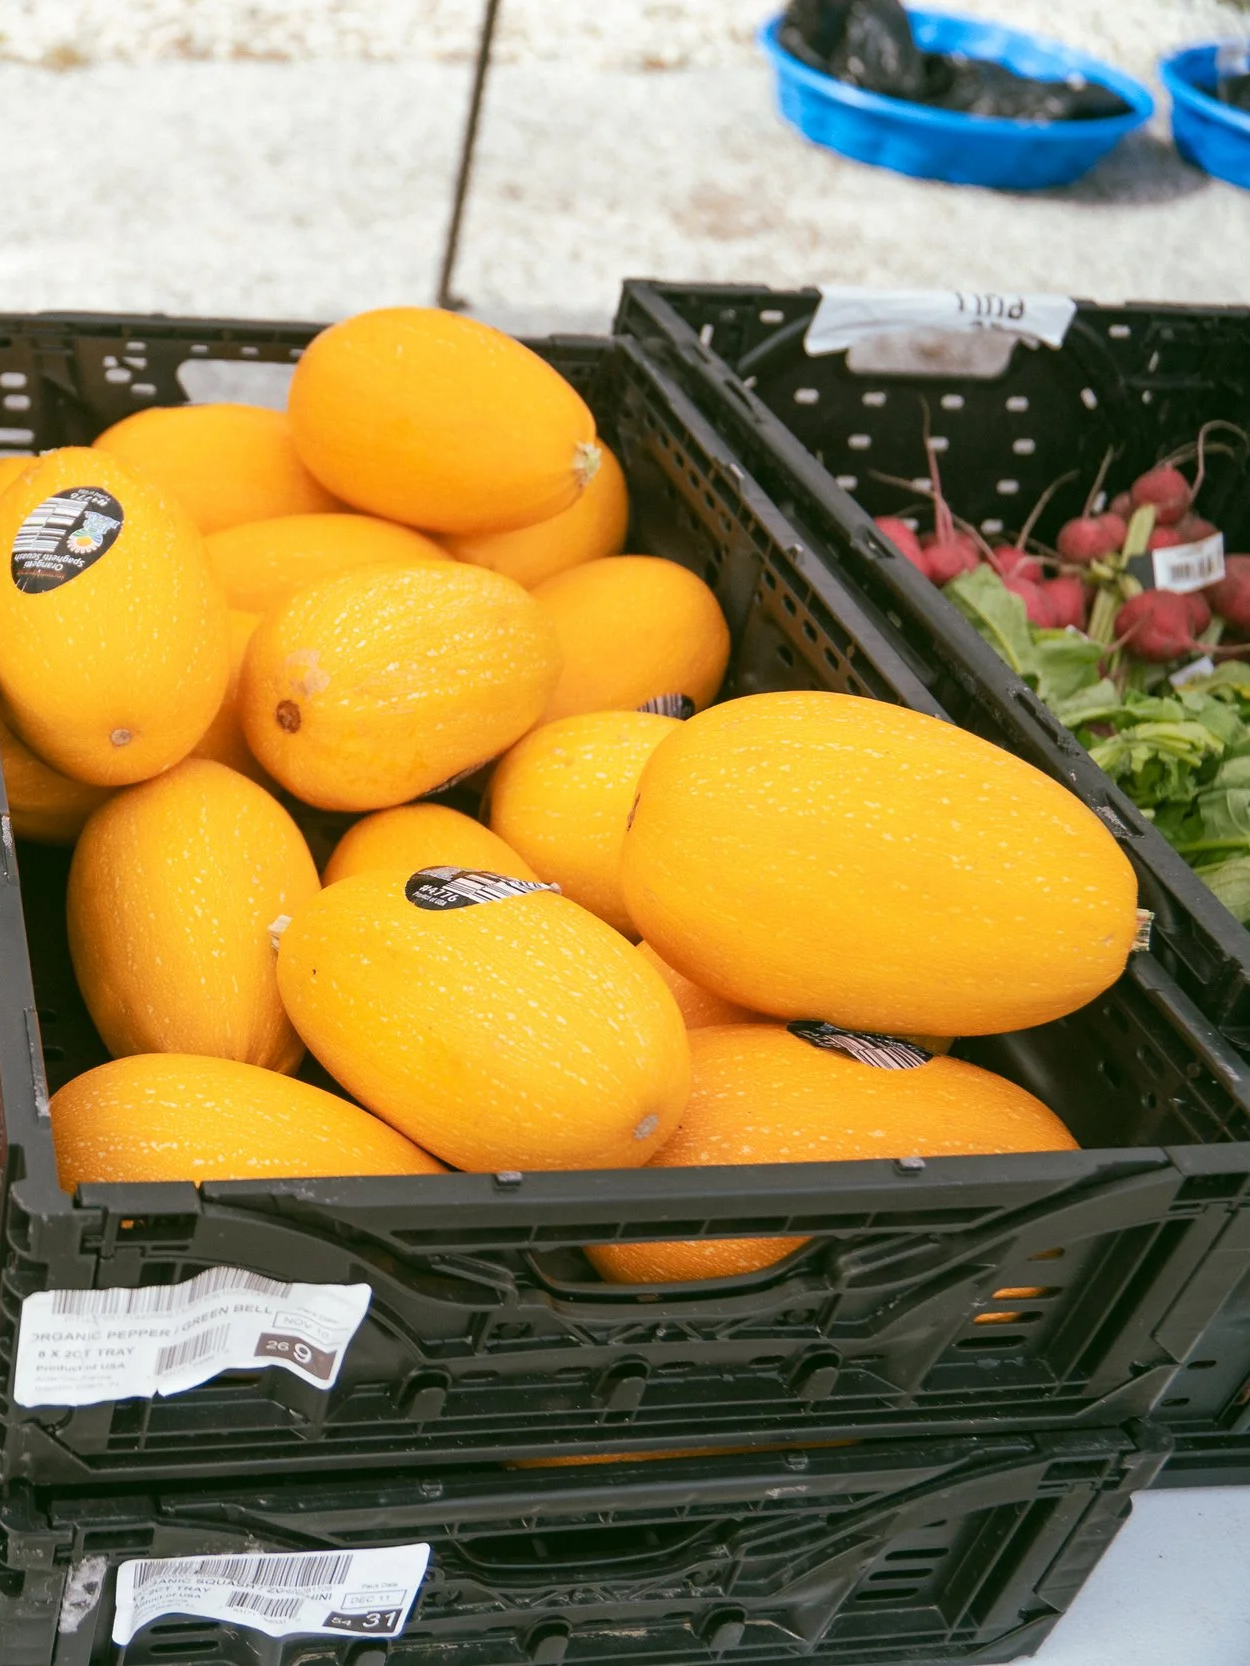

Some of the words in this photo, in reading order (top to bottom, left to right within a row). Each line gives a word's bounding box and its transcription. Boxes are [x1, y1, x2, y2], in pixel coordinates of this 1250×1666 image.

[42, 552, 86, 568] Spaghetti
[418, 884, 458, 903] #4776
[106, 1328, 171, 1341] PEPPER
[182, 1305, 230, 1331] GREEN
[233, 1303, 273, 1315] BELL
[50, 1348, 61, 1359] X
[97, 1346, 136, 1358] TRAY
[264, 1339, 292, 1353] 26
[293, 1342, 313, 1364] 9
[35, 1363, 83, 1373] Product
[361, 1610, 397, 1630] 31
